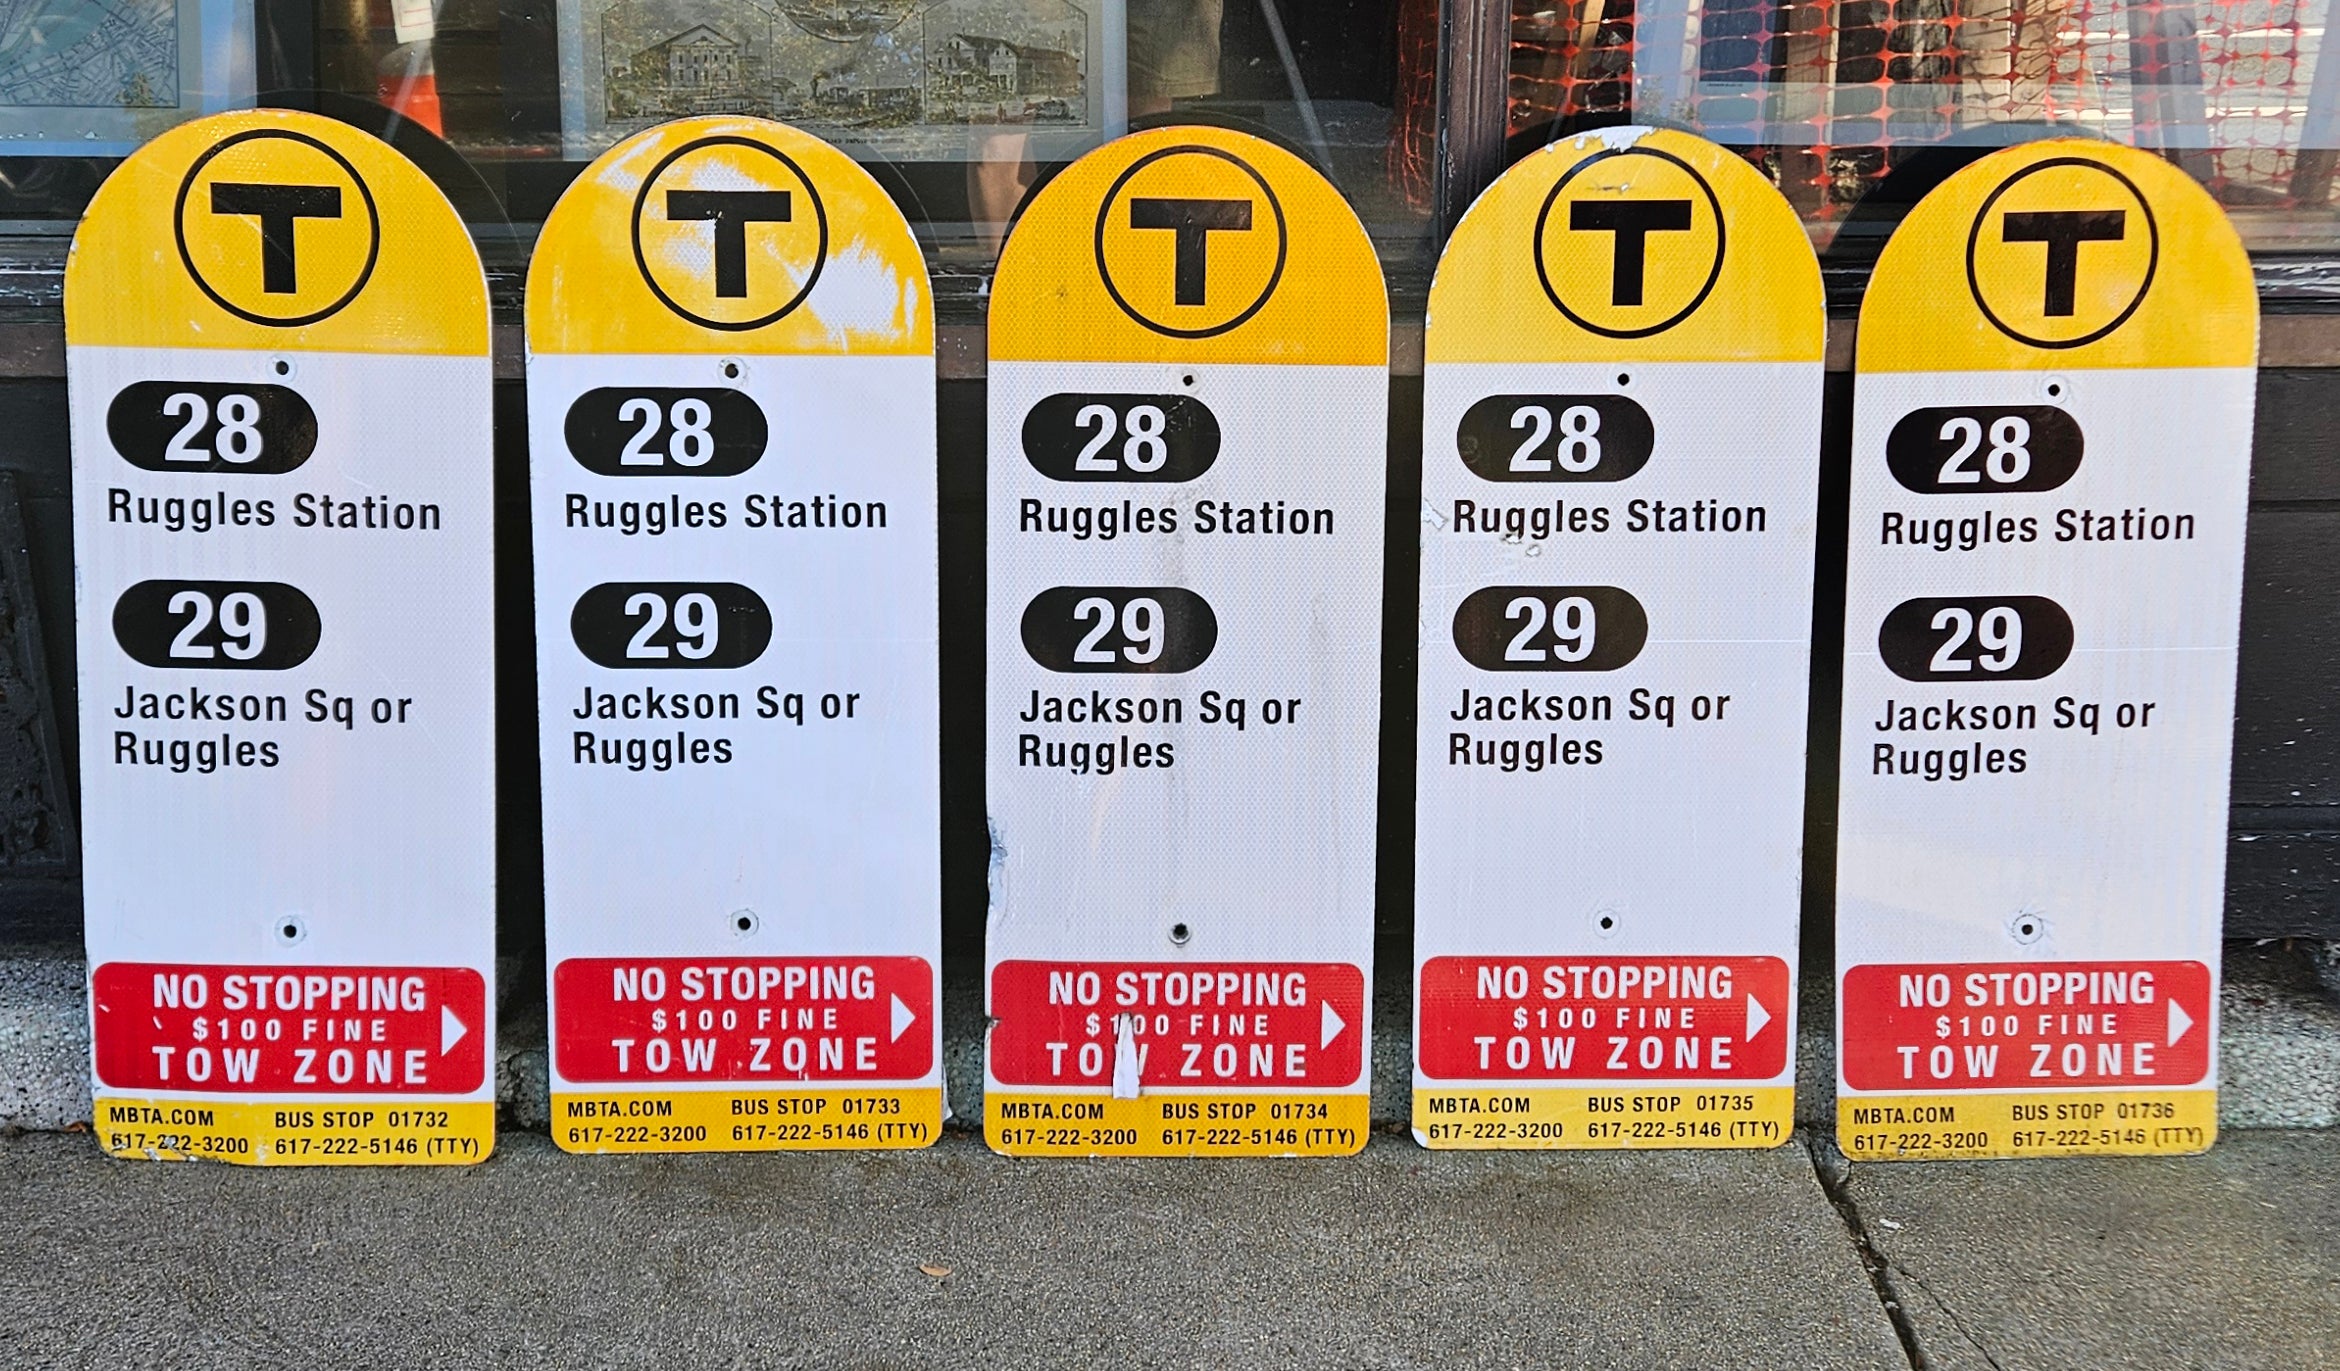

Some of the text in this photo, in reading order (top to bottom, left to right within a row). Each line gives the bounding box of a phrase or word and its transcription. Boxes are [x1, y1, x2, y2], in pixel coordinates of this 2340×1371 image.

[210, 183, 341, 294] T
[666, 190, 791, 298] T
[1130, 198, 1252, 306] T
[1570, 200, 1692, 306] T
[2002, 210, 2126, 316] T
[164, 393, 262, 463] 28
[619, 399, 714, 466] 28
[1075, 405, 1167, 472] 28
[1509, 406, 1600, 472] 28
[1938, 416, 2030, 483] 28
[109, 488, 439, 532] Ruggles Station
[566, 494, 886, 535] Ruggles Station
[1021, 499, 1333, 540] Ruggles Station
[1454, 499, 1765, 540] Ruggles Station
[1882, 509, 2193, 551] Ruggles Station
[169, 591, 266, 659] 29
[625, 593, 718, 659] 29
[1074, 598, 1164, 663] 29
[1505, 597, 1595, 662] 29
[1930, 607, 2022, 671] 29
[115, 686, 412, 730] Jackson Sq or
[573, 686, 859, 725] Jackson Sq or
[1020, 690, 1301, 731] Jackson Sq or
[1451, 688, 1730, 727] Jackson Sq or
[1875, 696, 2155, 735] Jackson Sq or
[115, 731, 279, 773] Ruggles
[574, 732, 732, 771] Ruggles
[1020, 734, 1174, 775] Ruggles
[1450, 733, 1602, 772] Ruggles
[1873, 742, 2026, 781] Ruggles
[154, 974, 425, 1011] NO STOPPING
[614, 966, 874, 1001] NO STOPPING
[1050, 972, 1305, 1006] NO STOPPING
[1478, 966, 1732, 999] NO STOPPING
[1900, 972, 2153, 1007] NO STOPPING
[193, 1017, 385, 1041] $100 FINE
[652, 1008, 836, 1033] $100 FINE
[1086, 1013, 1267, 1037] $100 FINE
[1514, 1006, 1694, 1031] $100 FINE
[1936, 1014, 2116, 1039] $100 FINE
[152, 1046, 426, 1083] TOW ZONE
[612, 1037, 876, 1072] TOW ZONE
[1181, 1043, 1305, 1077] ZONE
[1474, 1036, 1731, 1069] TOW ZONE
[1897, 1043, 2154, 1079] TOW ZONE
[110, 1107, 213, 1126] MBTA.COM
[276, 1112, 447, 1128] BUS STOP 01732
[568, 1101, 671, 1117] MBTA.COM
[732, 1098, 899, 1115] BUS STOP 01733
[1002, 1103, 1103, 1119] MBTA.COM
[1163, 1103, 1327, 1119] BUS STOP 01734
[1430, 1097, 1529, 1113] MBTA.COM
[1589, 1096, 1753, 1112] BUS STOP 01735
[1854, 1107, 1954, 1124] MBTA.COM
[2013, 1103, 2174, 1120] BUS STOP 01736
[111, 1133, 248, 1153] 617-222-3200
[276, 1138, 478, 1157] 617-222-5146 (TTY)
[569, 1126, 706, 1142] 617-222-3200
[733, 1123, 927, 1142] 617-222-5146 (TTY)
[1002, 1129, 1136, 1145] 617-222-3200
[1163, 1129, 1354, 1148] 617-222-5146 (TTY)
[1430, 1123, 1562, 1138] 617-222-3200
[1589, 1121, 1778, 1140] 617-222-5146 (TTY)
[1855, 1132, 1987, 1150] 617-222-3200
[2013, 1127, 2203, 1147] 617-222-5146 (TTY)
